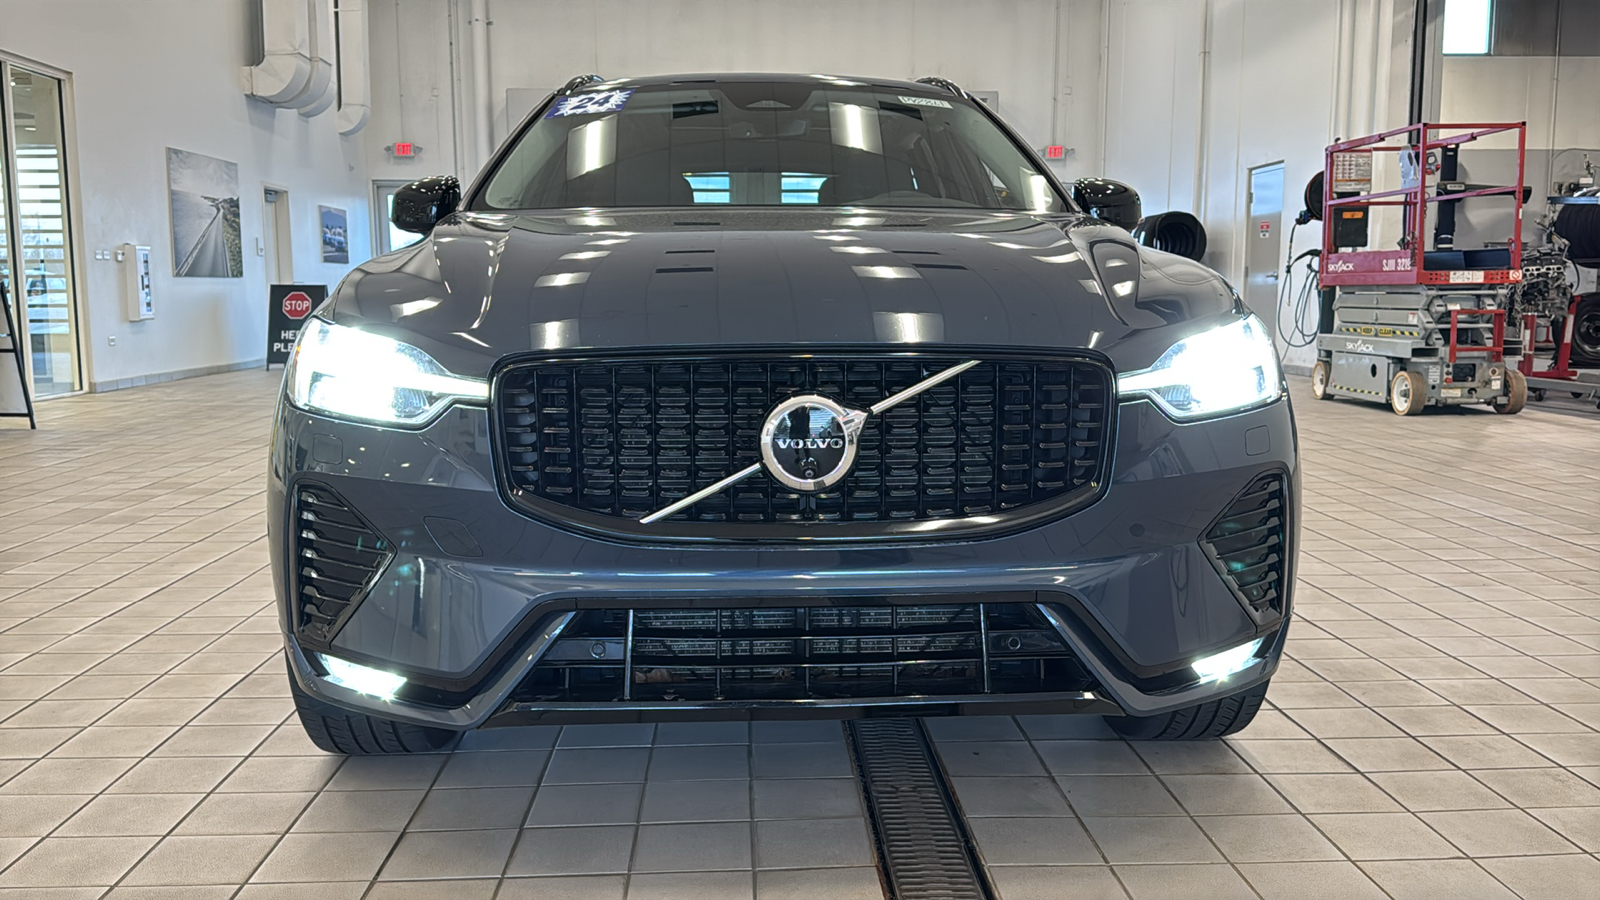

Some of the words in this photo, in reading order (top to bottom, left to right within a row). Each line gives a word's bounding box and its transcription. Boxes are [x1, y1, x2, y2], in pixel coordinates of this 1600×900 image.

[568, 94, 615, 110] 24
[396, 142, 412, 155] EXIT
[1047, 145, 1064, 158] EXIT
[284, 300, 311, 311] STOP
[1345, 340, 1375, 352] SKYJACK
[775, 438, 844, 449] VOLVO
